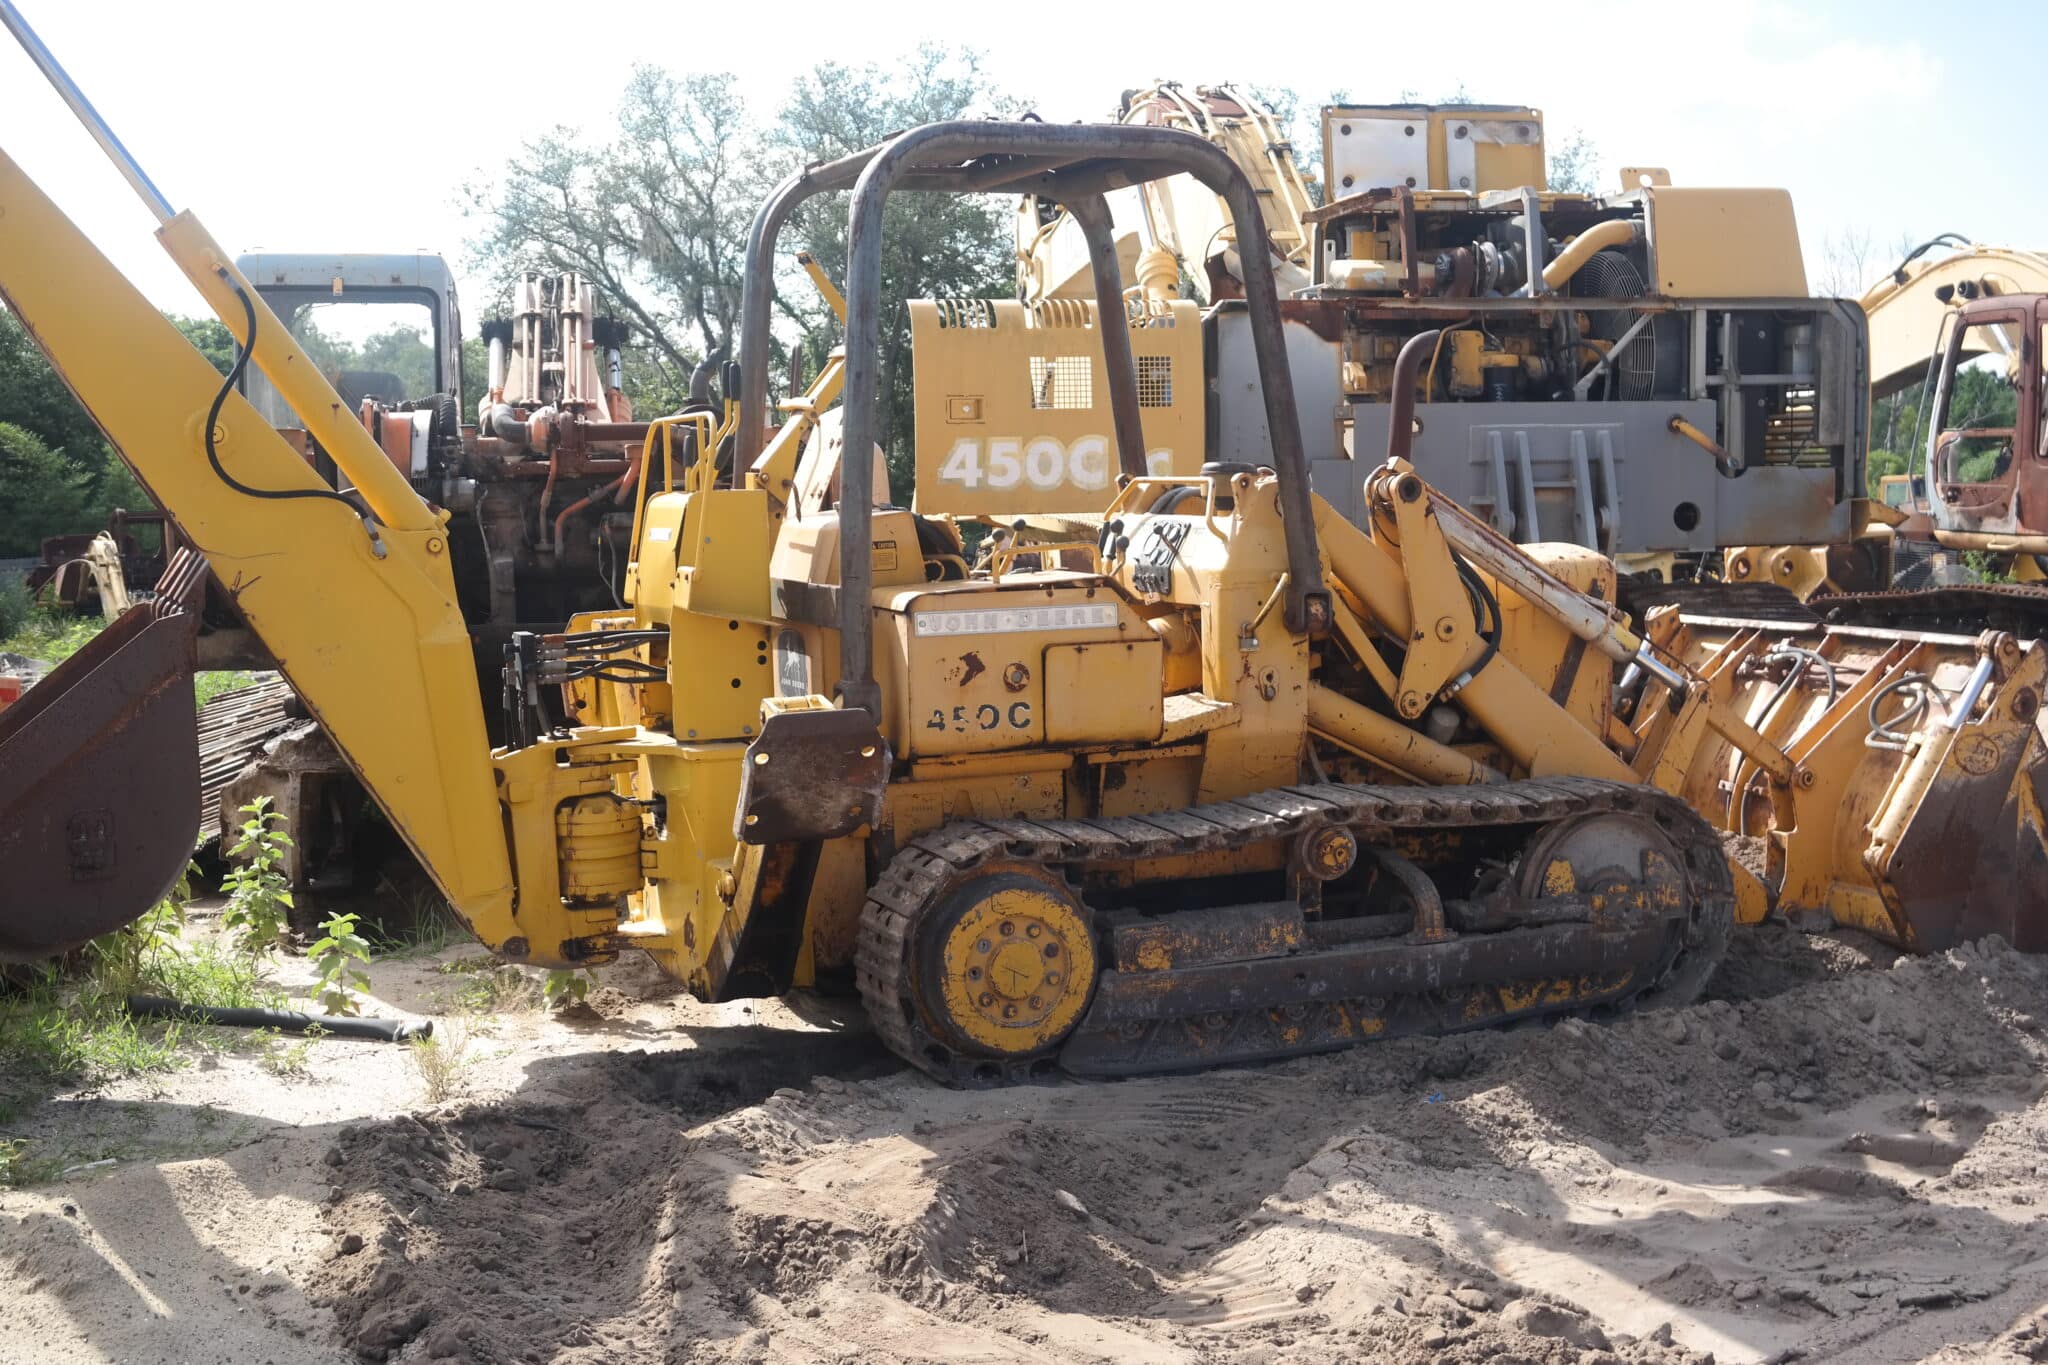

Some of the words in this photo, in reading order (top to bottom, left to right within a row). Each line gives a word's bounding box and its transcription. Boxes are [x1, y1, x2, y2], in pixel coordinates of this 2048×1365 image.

[940, 436, 1107, 489] 450C
[928, 614, 998, 632] JOHN
[1017, 606, 1104, 628] DEERE
[926, 701, 1031, 732] 450C
